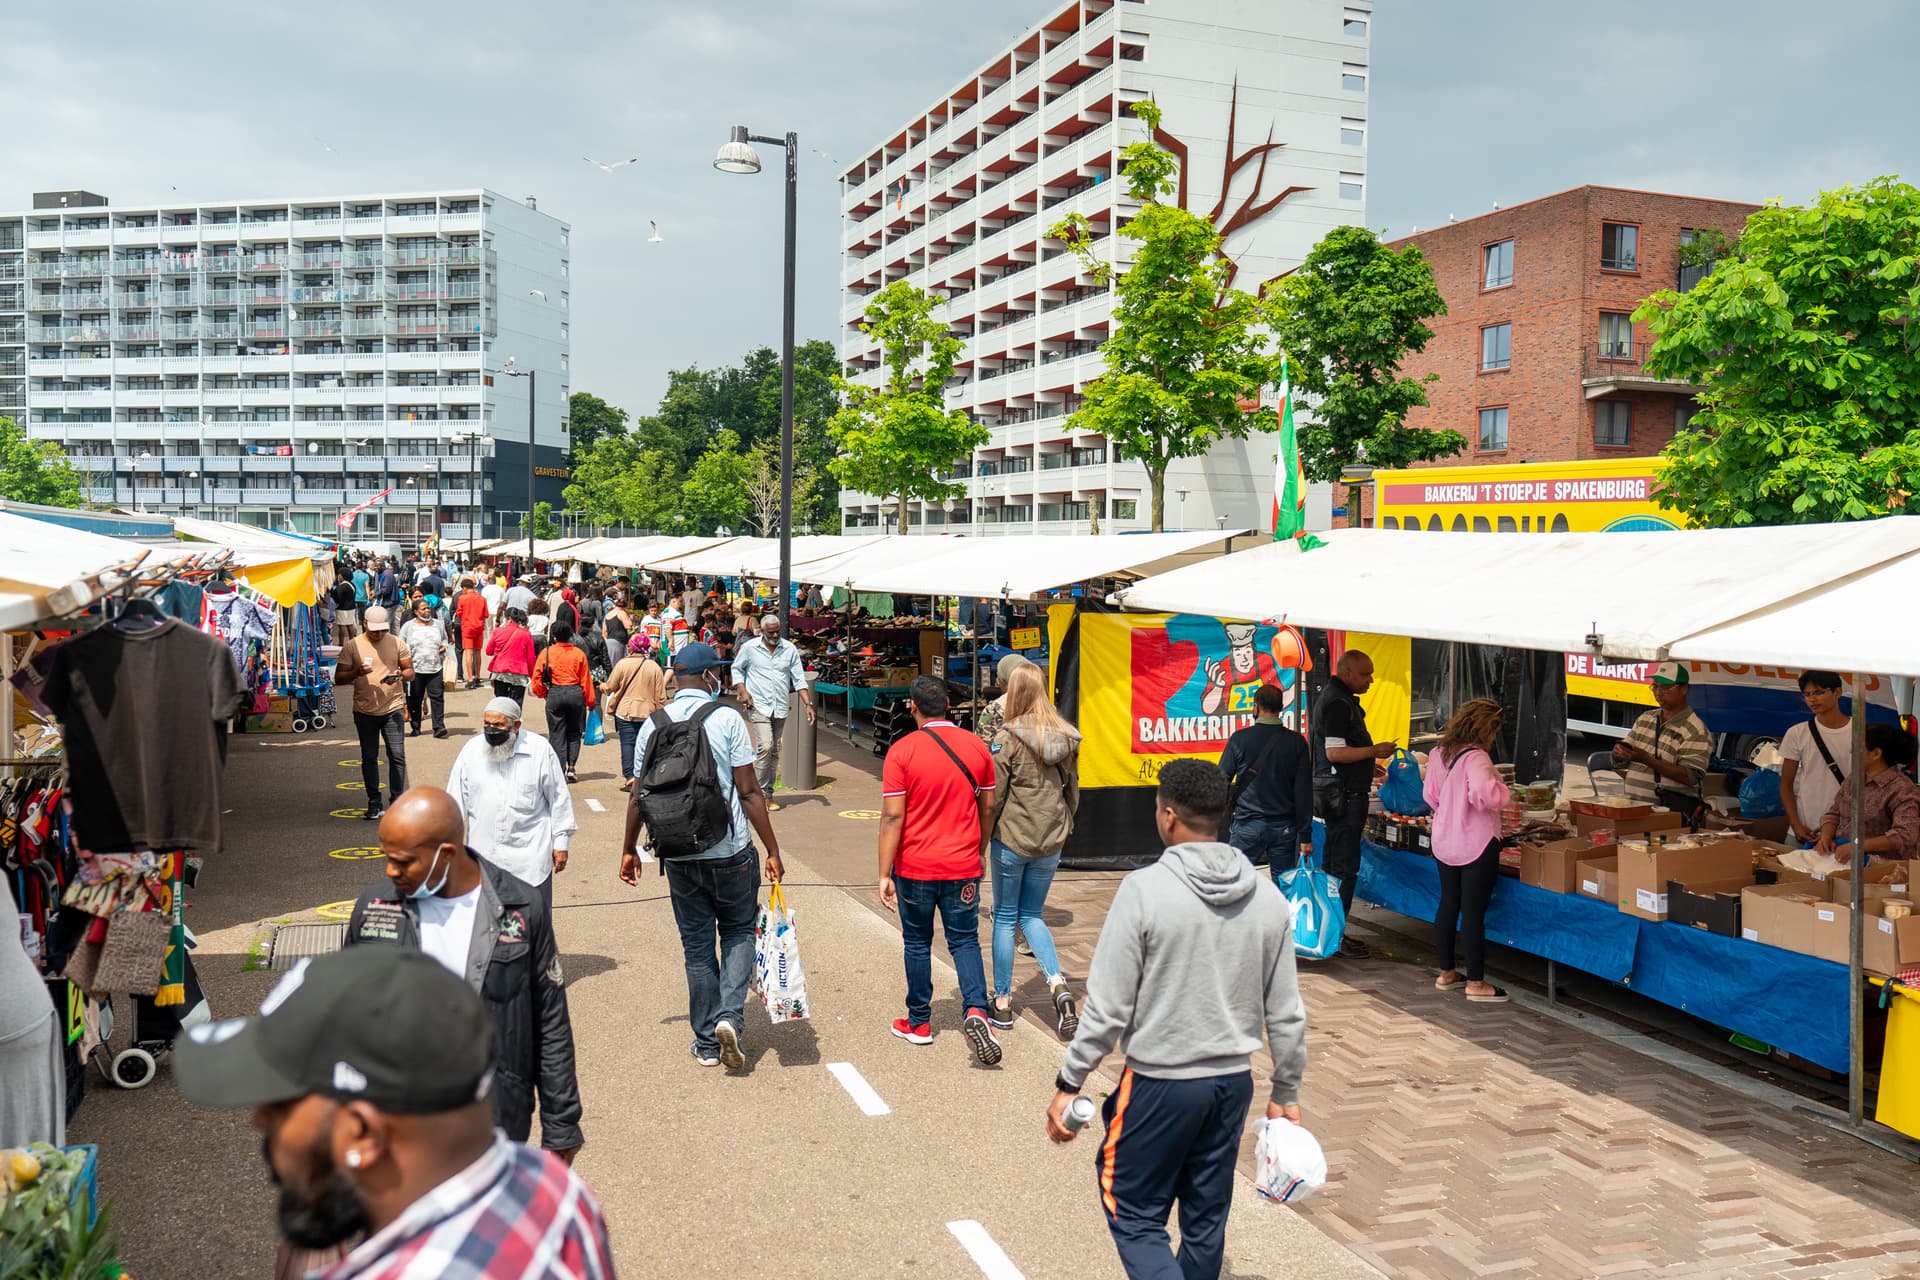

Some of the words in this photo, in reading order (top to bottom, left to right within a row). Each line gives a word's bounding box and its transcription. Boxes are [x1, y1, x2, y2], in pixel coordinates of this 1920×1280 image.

[535, 467, 568, 478] GRAVESTEIN
[1424, 484, 1478, 503] BAKKERIJ
[1494, 482, 1548, 501] STOEPJE
[1554, 479, 1646, 500] SPAKENBURG
[1567, 654, 1588, 674] DE
[1592, 656, 1649, 681] MARKT
[779, 952, 788, 988] ACTION
